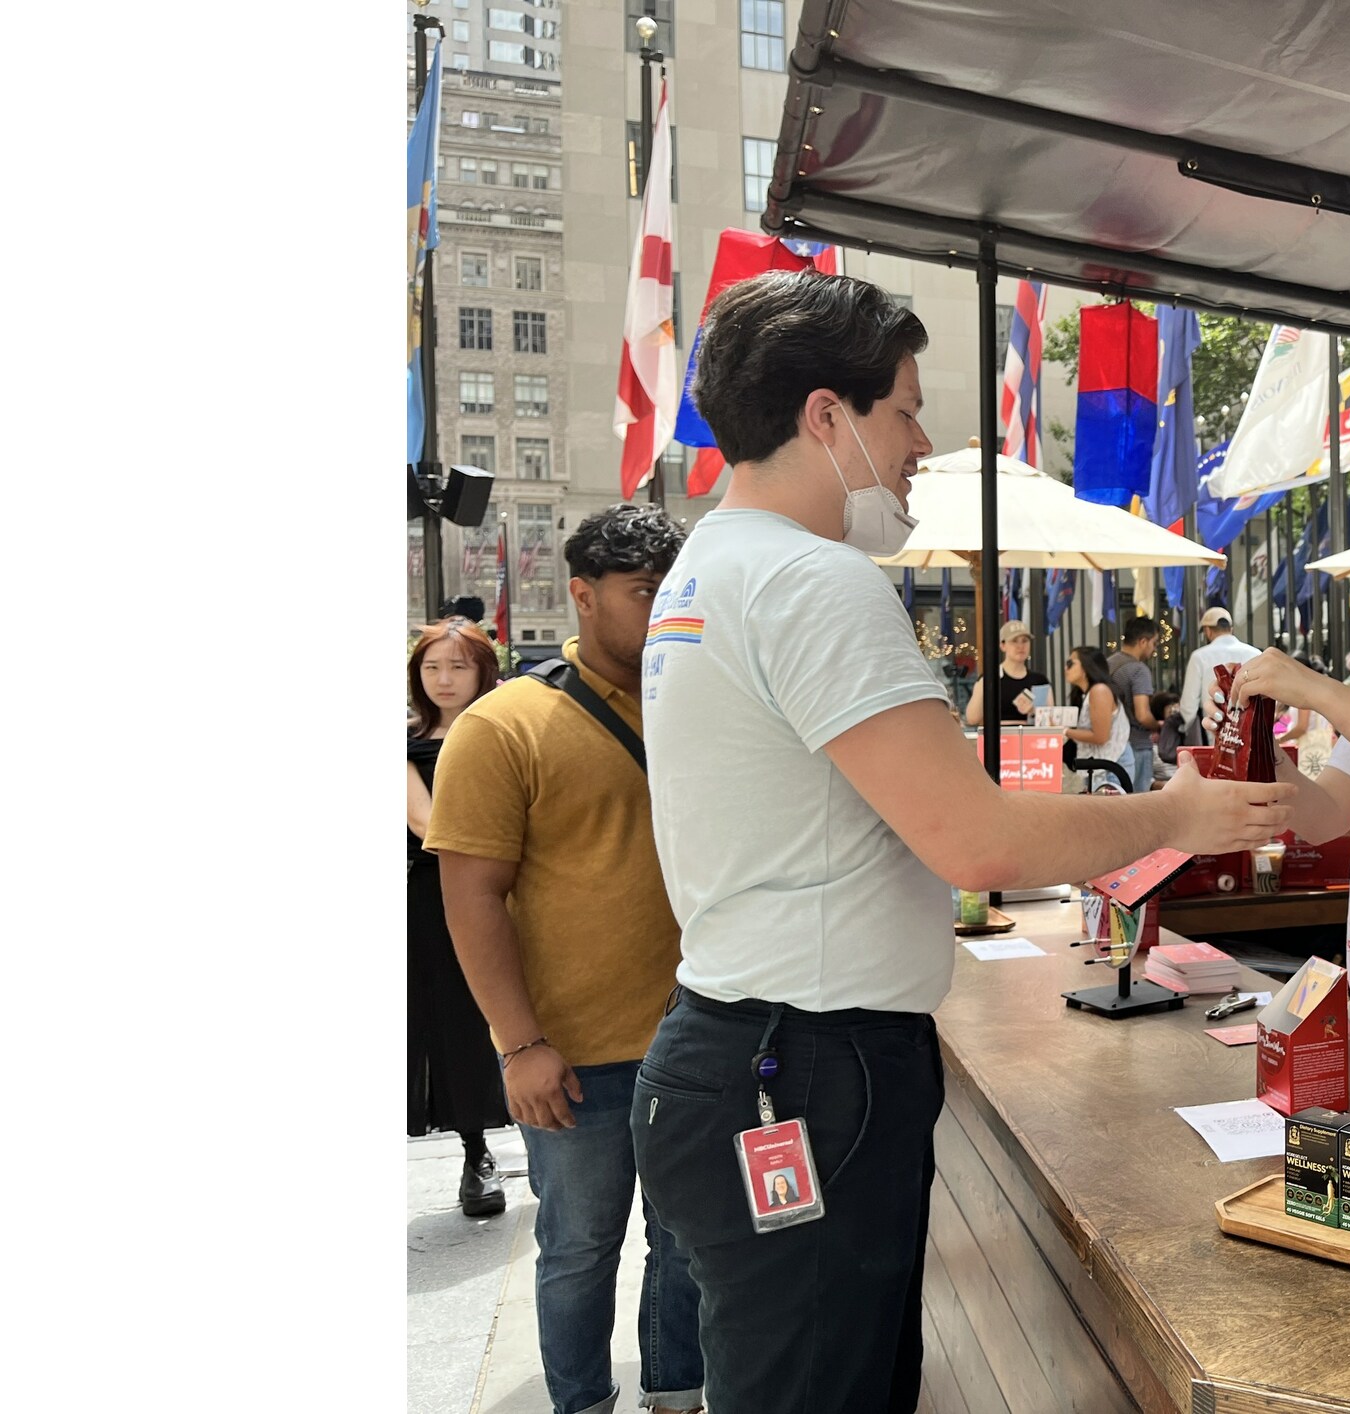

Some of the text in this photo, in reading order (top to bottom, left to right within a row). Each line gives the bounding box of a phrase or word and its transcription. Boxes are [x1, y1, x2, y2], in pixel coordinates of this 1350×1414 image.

[1299, 1124, 1337, 1137] Dietary Supplement
[1286, 1156, 1327, 1174] WELLNESS
[1291, 1208, 1305, 1217] VEGGIE
[1305, 1211, 1315, 1220] SOFT
